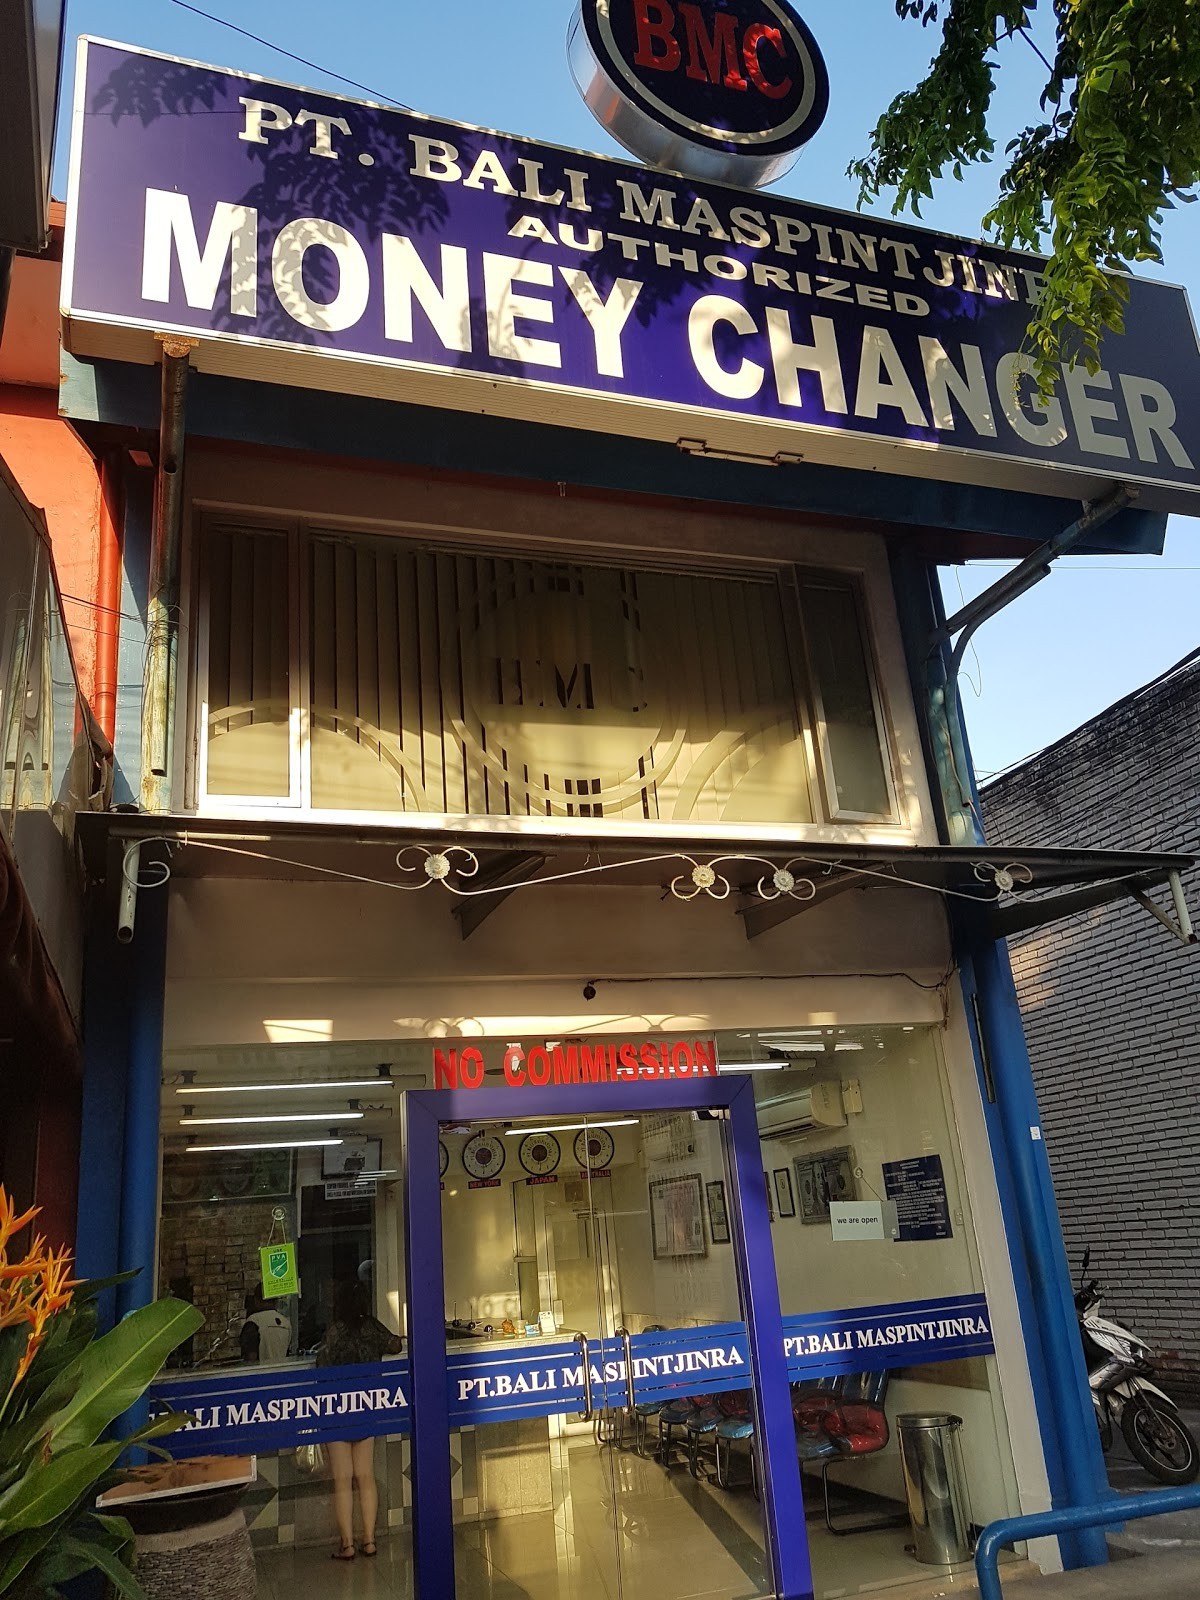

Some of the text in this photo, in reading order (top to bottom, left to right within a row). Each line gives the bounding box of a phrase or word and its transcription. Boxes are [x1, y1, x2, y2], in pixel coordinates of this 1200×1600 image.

[634, 0, 793, 99] BMC
[238, 95, 375, 166] PT.
[409, 133, 592, 213] BALI
[508, 216, 930, 317] AUTHORIZED
[141, 187, 1197, 470] MONEY CHANGER
[434, 1040, 718, 1090] NO COMMISSION
[529, 1176, 555, 1185] JAPAN
[861, 1217, 879, 1225] open
[783, 1316, 989, 1357] PT.BALI MASPINTJINRA
[226, 1387, 408, 1426] MASPINTJINRA
[457, 1368, 558, 1401] PT.BALI
